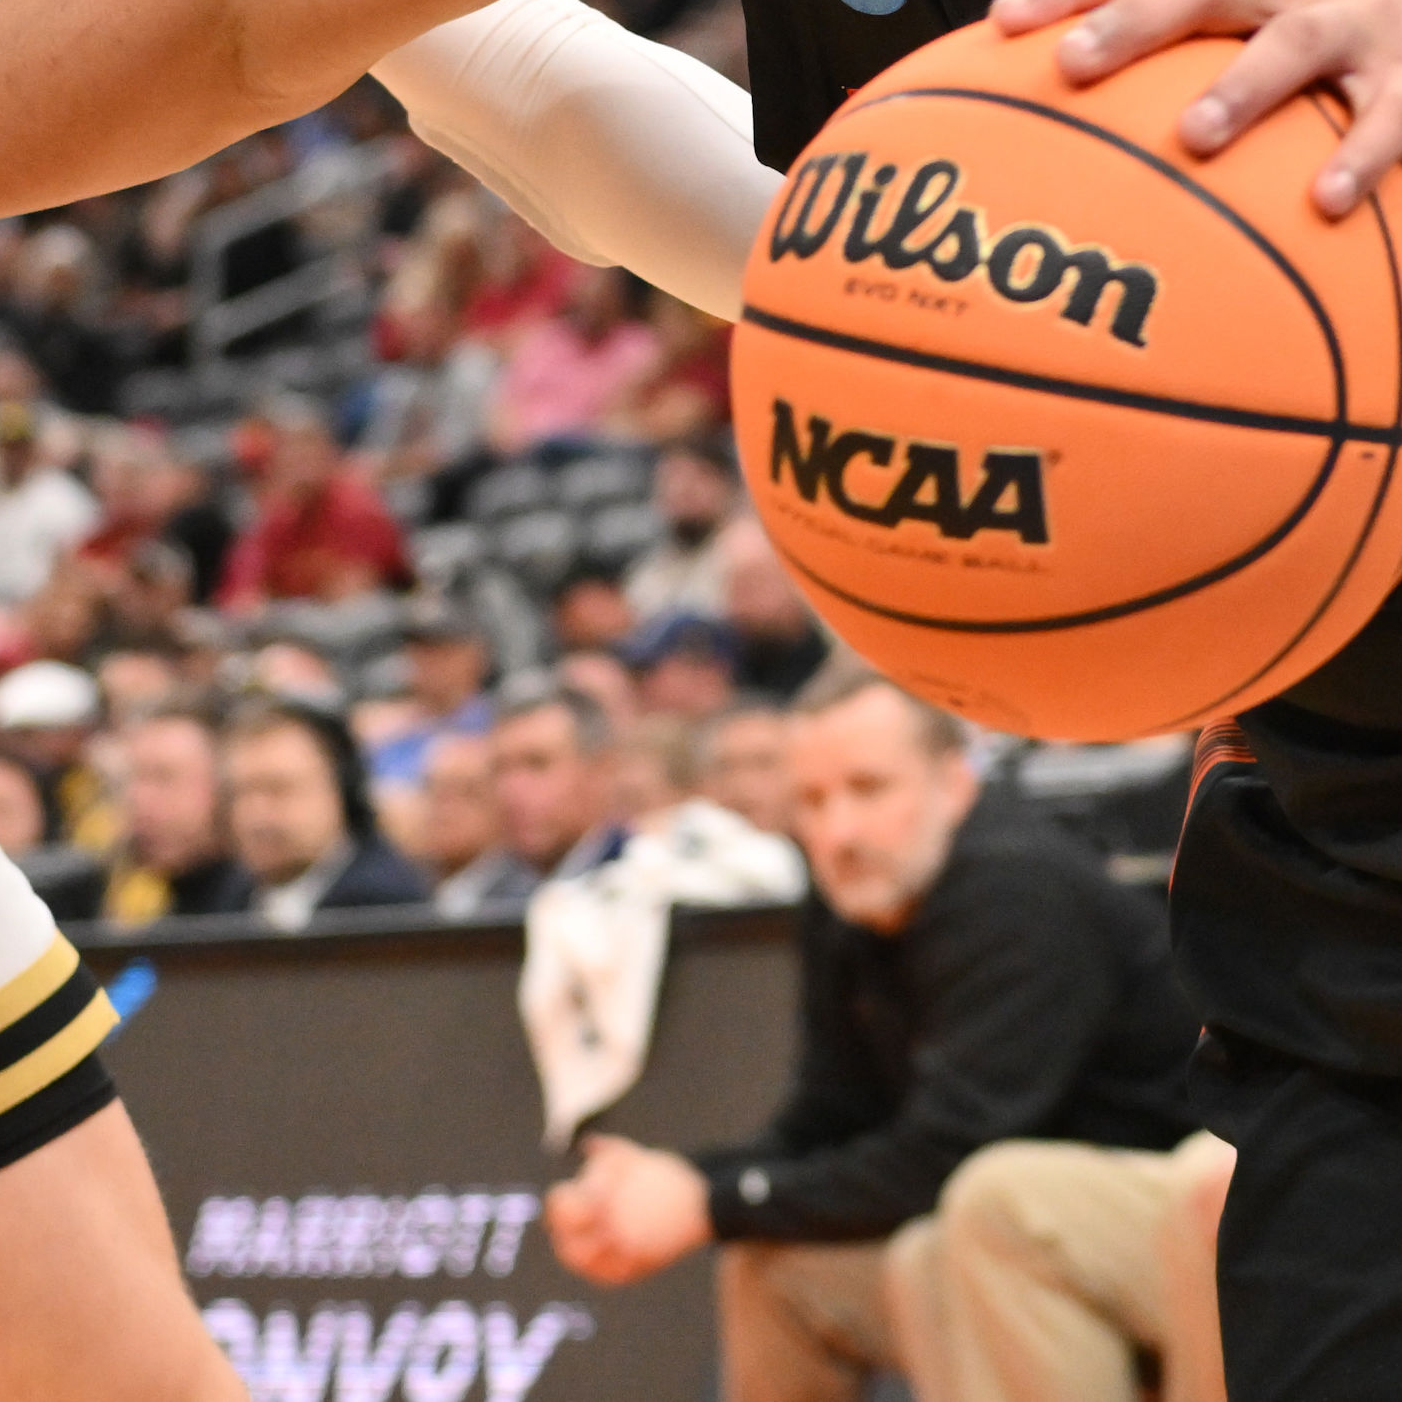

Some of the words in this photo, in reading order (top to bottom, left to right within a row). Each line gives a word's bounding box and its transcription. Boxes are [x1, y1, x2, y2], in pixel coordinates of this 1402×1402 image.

[769, 150, 1159, 349] Wilson
[769, 395, 1052, 544] NCAA
[200, 1298, 570, 1402] ONVOY
